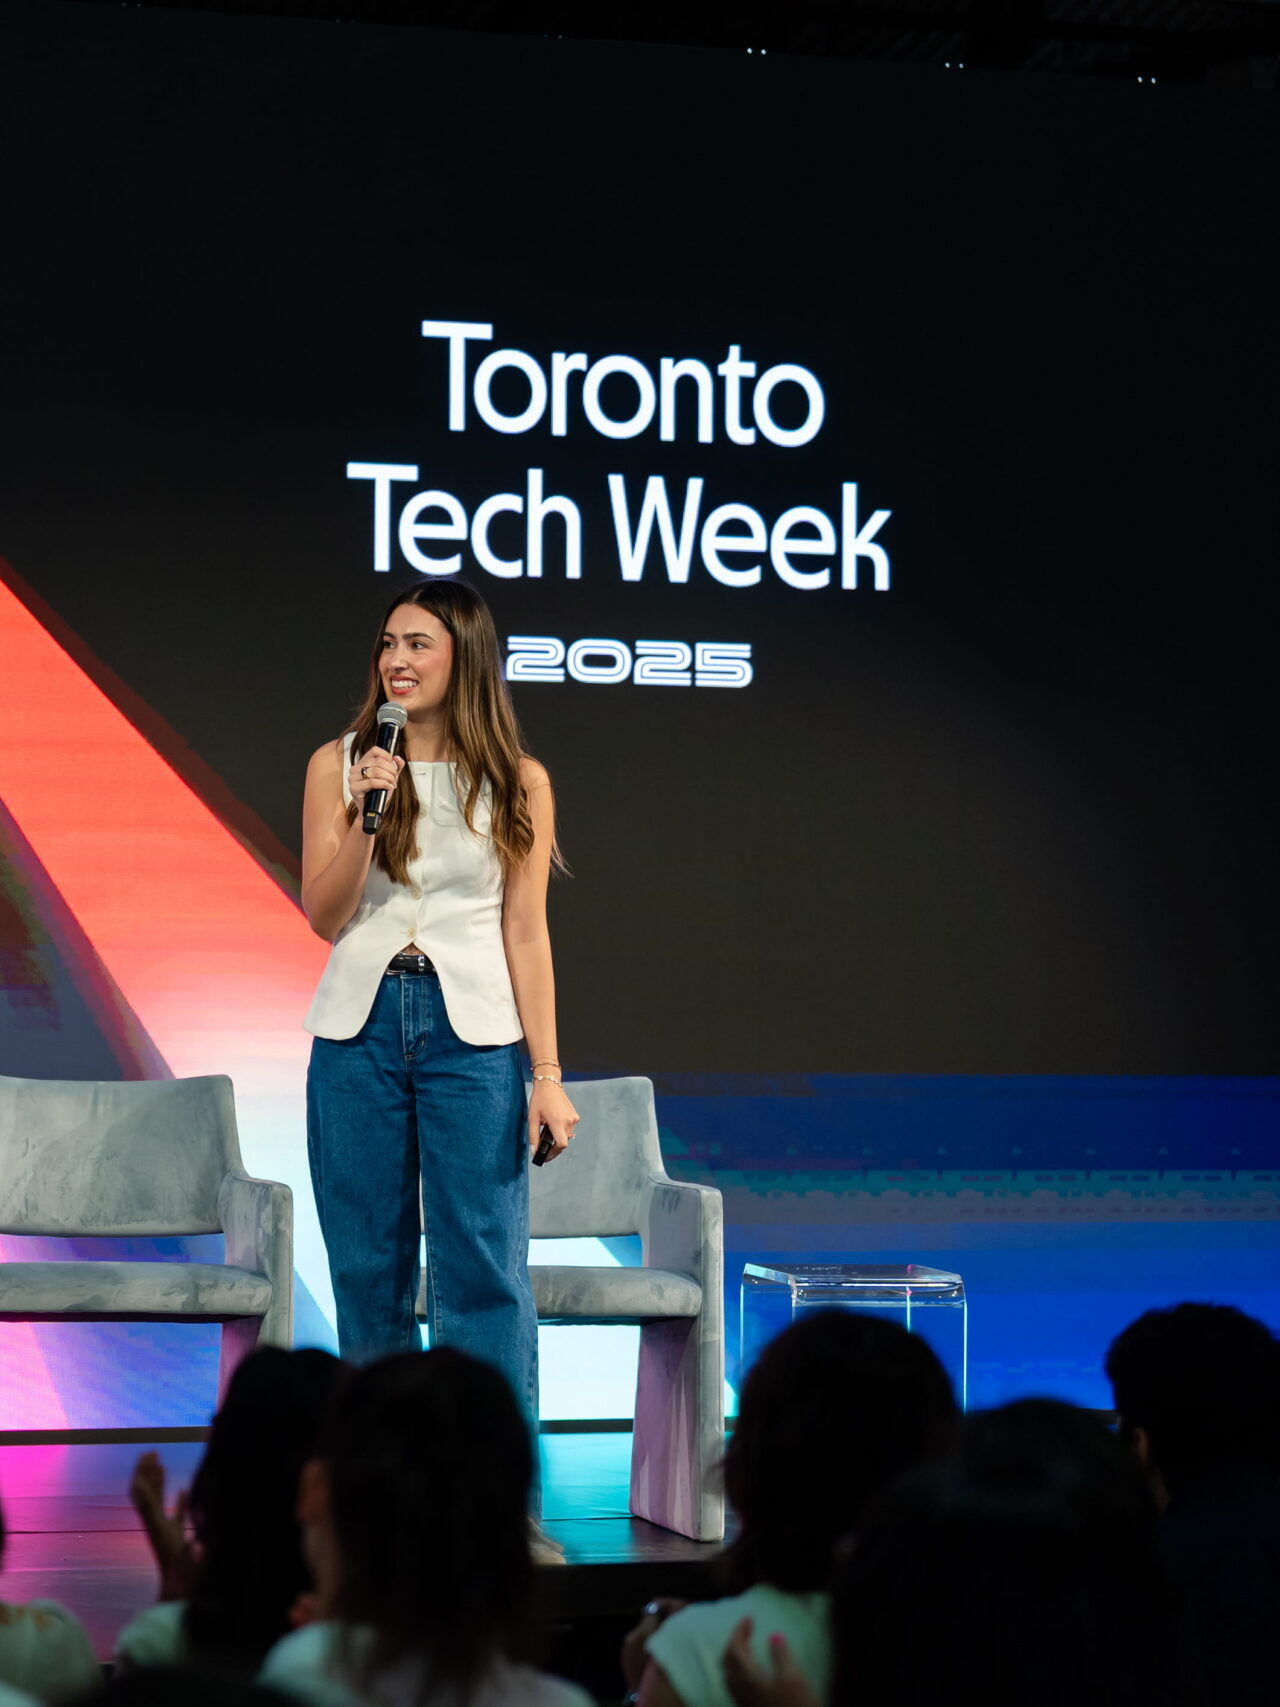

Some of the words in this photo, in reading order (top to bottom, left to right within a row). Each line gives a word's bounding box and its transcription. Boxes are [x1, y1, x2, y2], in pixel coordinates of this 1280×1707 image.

[421, 320, 825, 448] Toronto
[346, 461, 582, 580] Tech
[607, 473, 892, 592] Week
[505, 635, 754, 689] 2025
